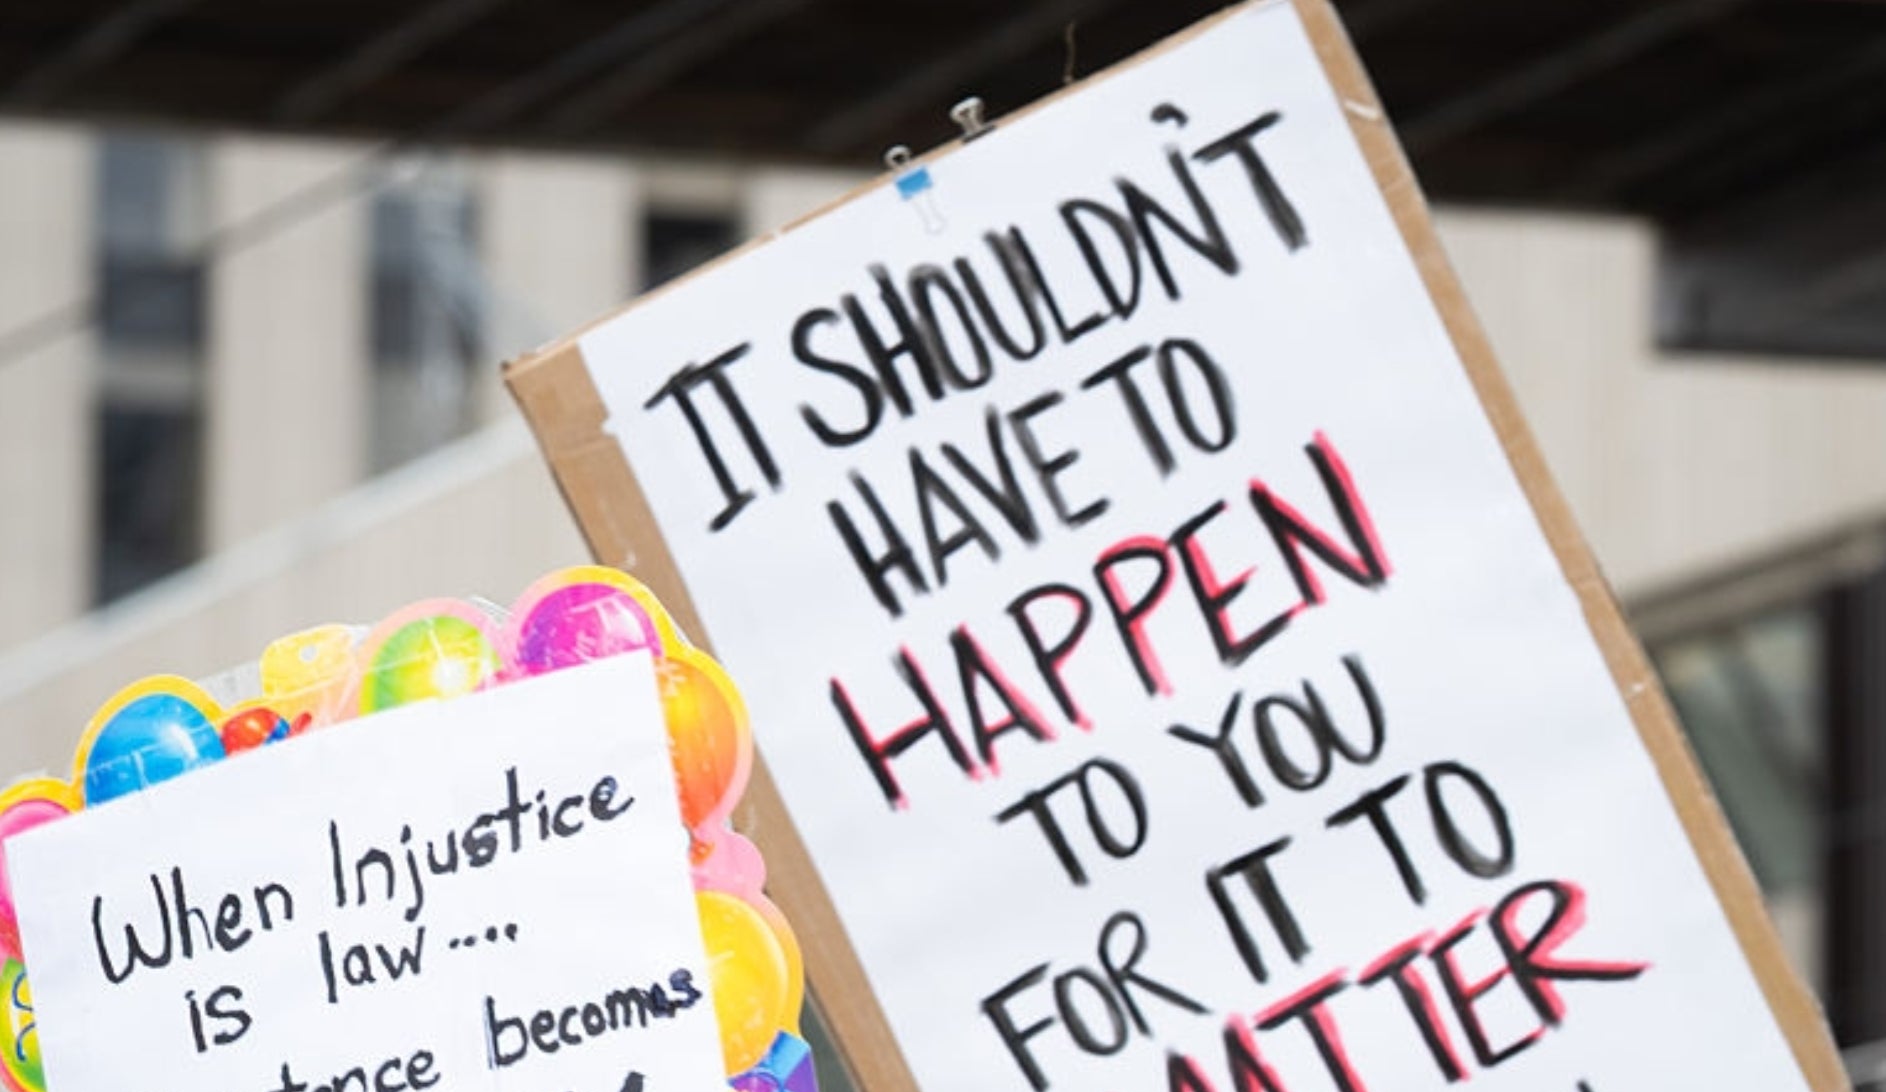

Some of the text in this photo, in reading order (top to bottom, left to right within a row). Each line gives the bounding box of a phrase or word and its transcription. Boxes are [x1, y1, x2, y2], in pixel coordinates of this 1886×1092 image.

[644, 103, 1310, 532] IT SHOULDN'T
[825, 337, 1237, 618] HAVE TO
[829, 430, 1393, 811] HAPPEN
[92, 766, 635, 985] When Injustice
[994, 653, 1385, 887] TO YOU
[1205, 836, 1311, 984] IT
[1325, 760, 1515, 905] TO
